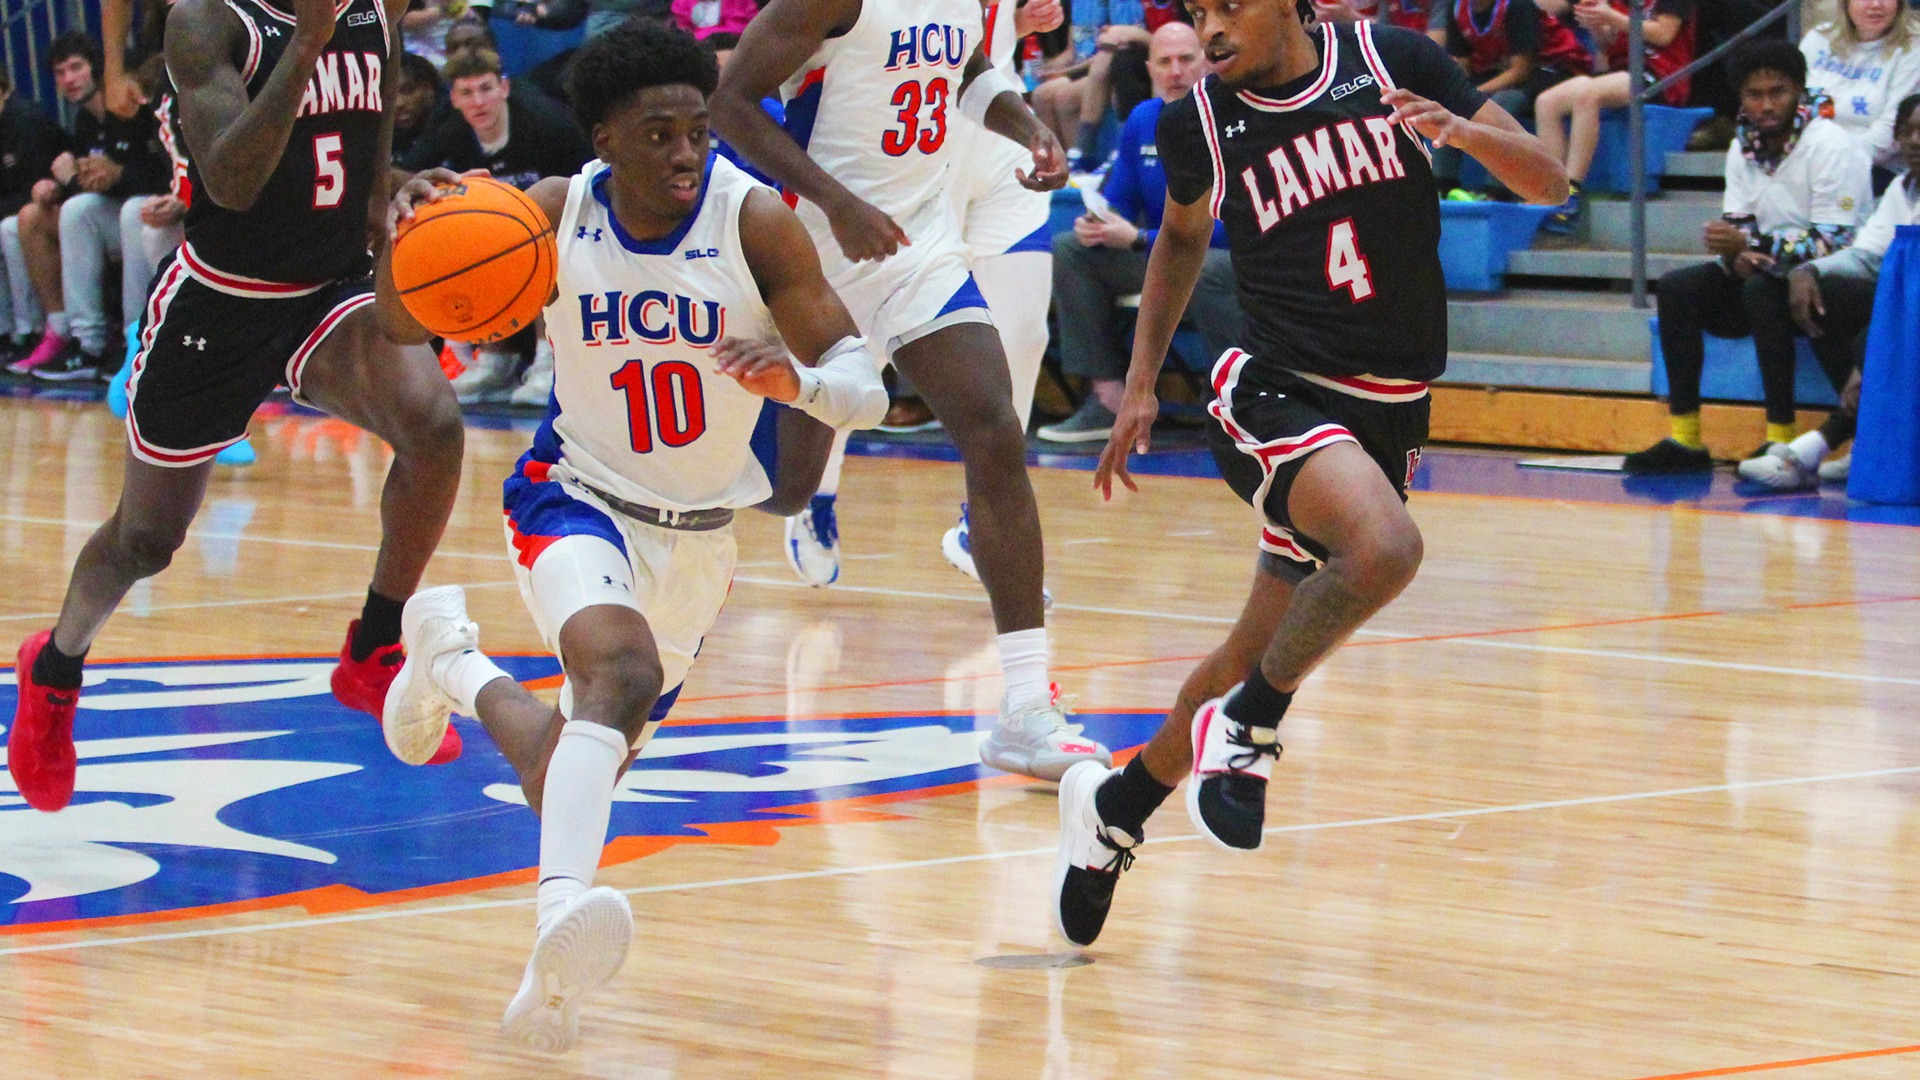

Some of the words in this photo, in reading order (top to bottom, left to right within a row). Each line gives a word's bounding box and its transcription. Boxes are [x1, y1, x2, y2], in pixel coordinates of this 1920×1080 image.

[296, 51, 383, 119] AMAR
[883, 23, 967, 72] HCU
[881, 76, 949, 157] 33
[312, 132, 347, 210] 5
[1240, 115, 1406, 235] LAMAR
[1324, 216, 1376, 304] 4
[578, 289, 726, 349] HCU
[610, 358, 706, 454] 10
